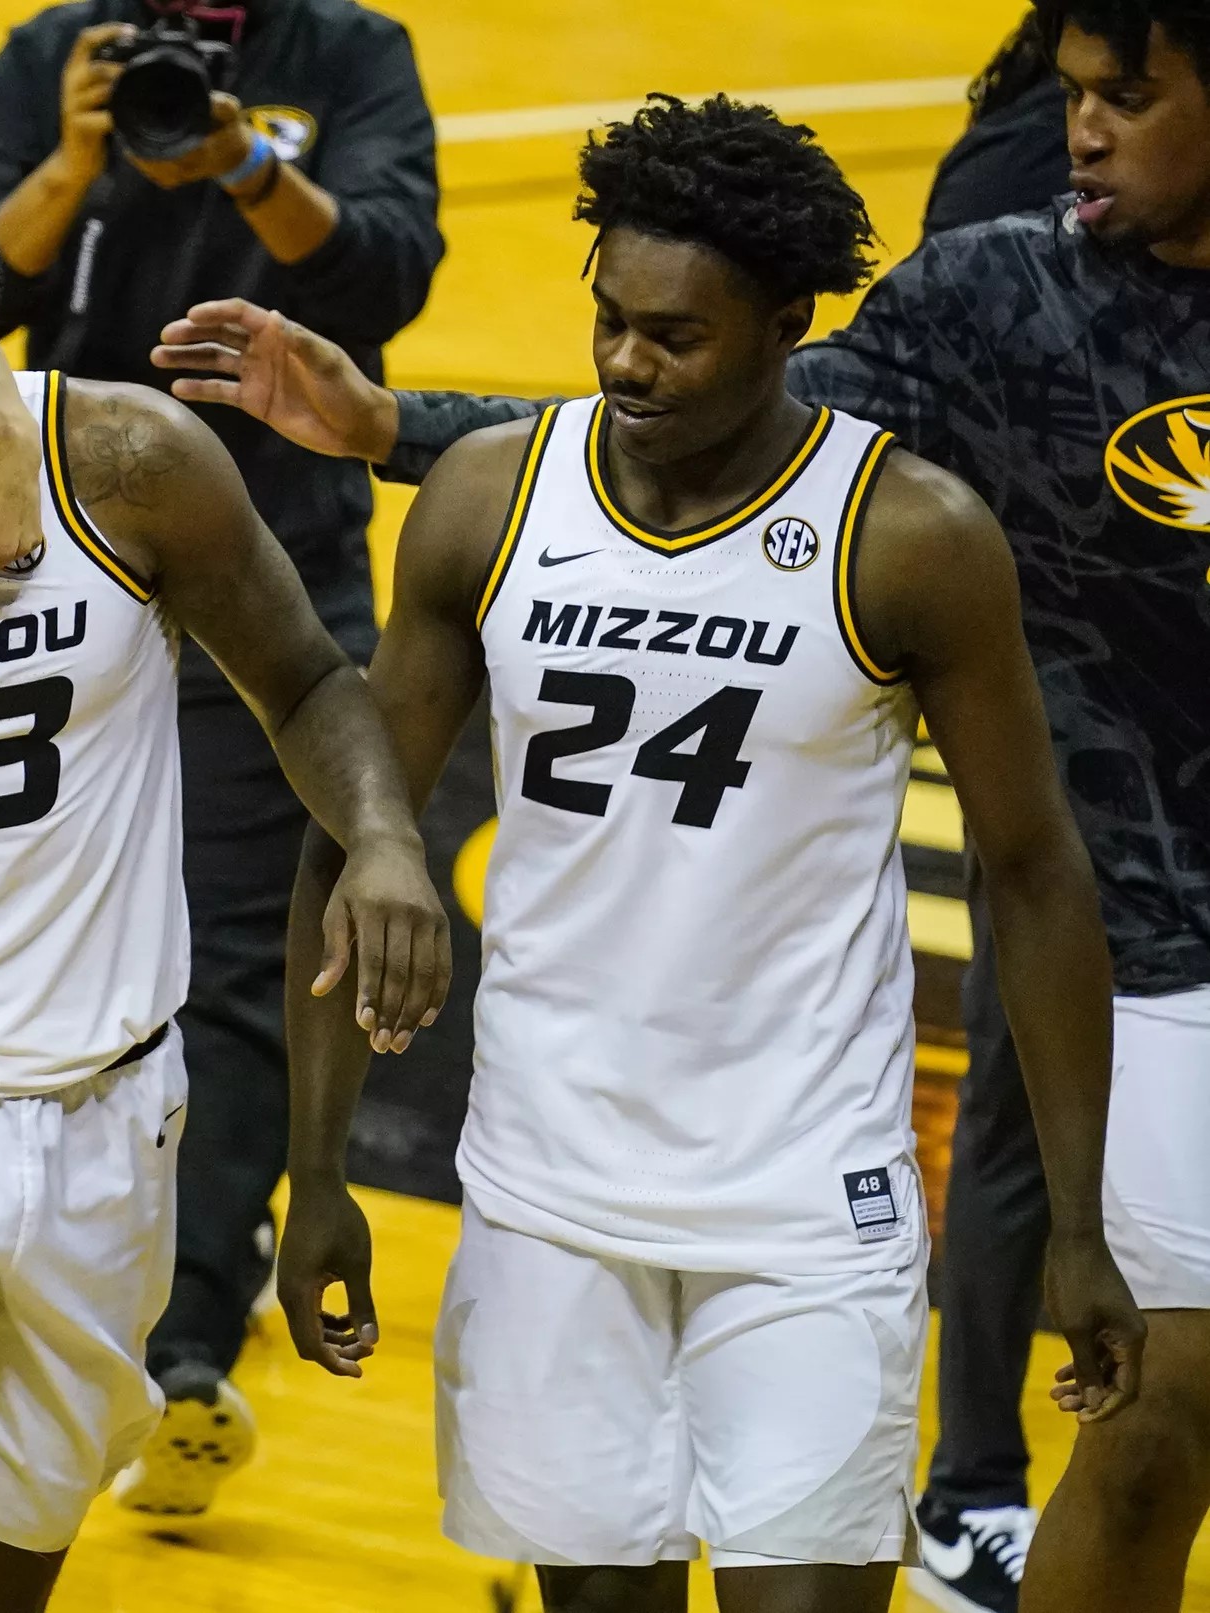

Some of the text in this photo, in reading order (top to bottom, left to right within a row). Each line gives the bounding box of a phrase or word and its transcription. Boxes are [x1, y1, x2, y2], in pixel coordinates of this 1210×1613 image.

[764, 517, 818, 568] SEC
[521, 599, 801, 666] MIZZOU
[521, 668, 764, 830] 24
[857, 1176, 881, 1194] 48
